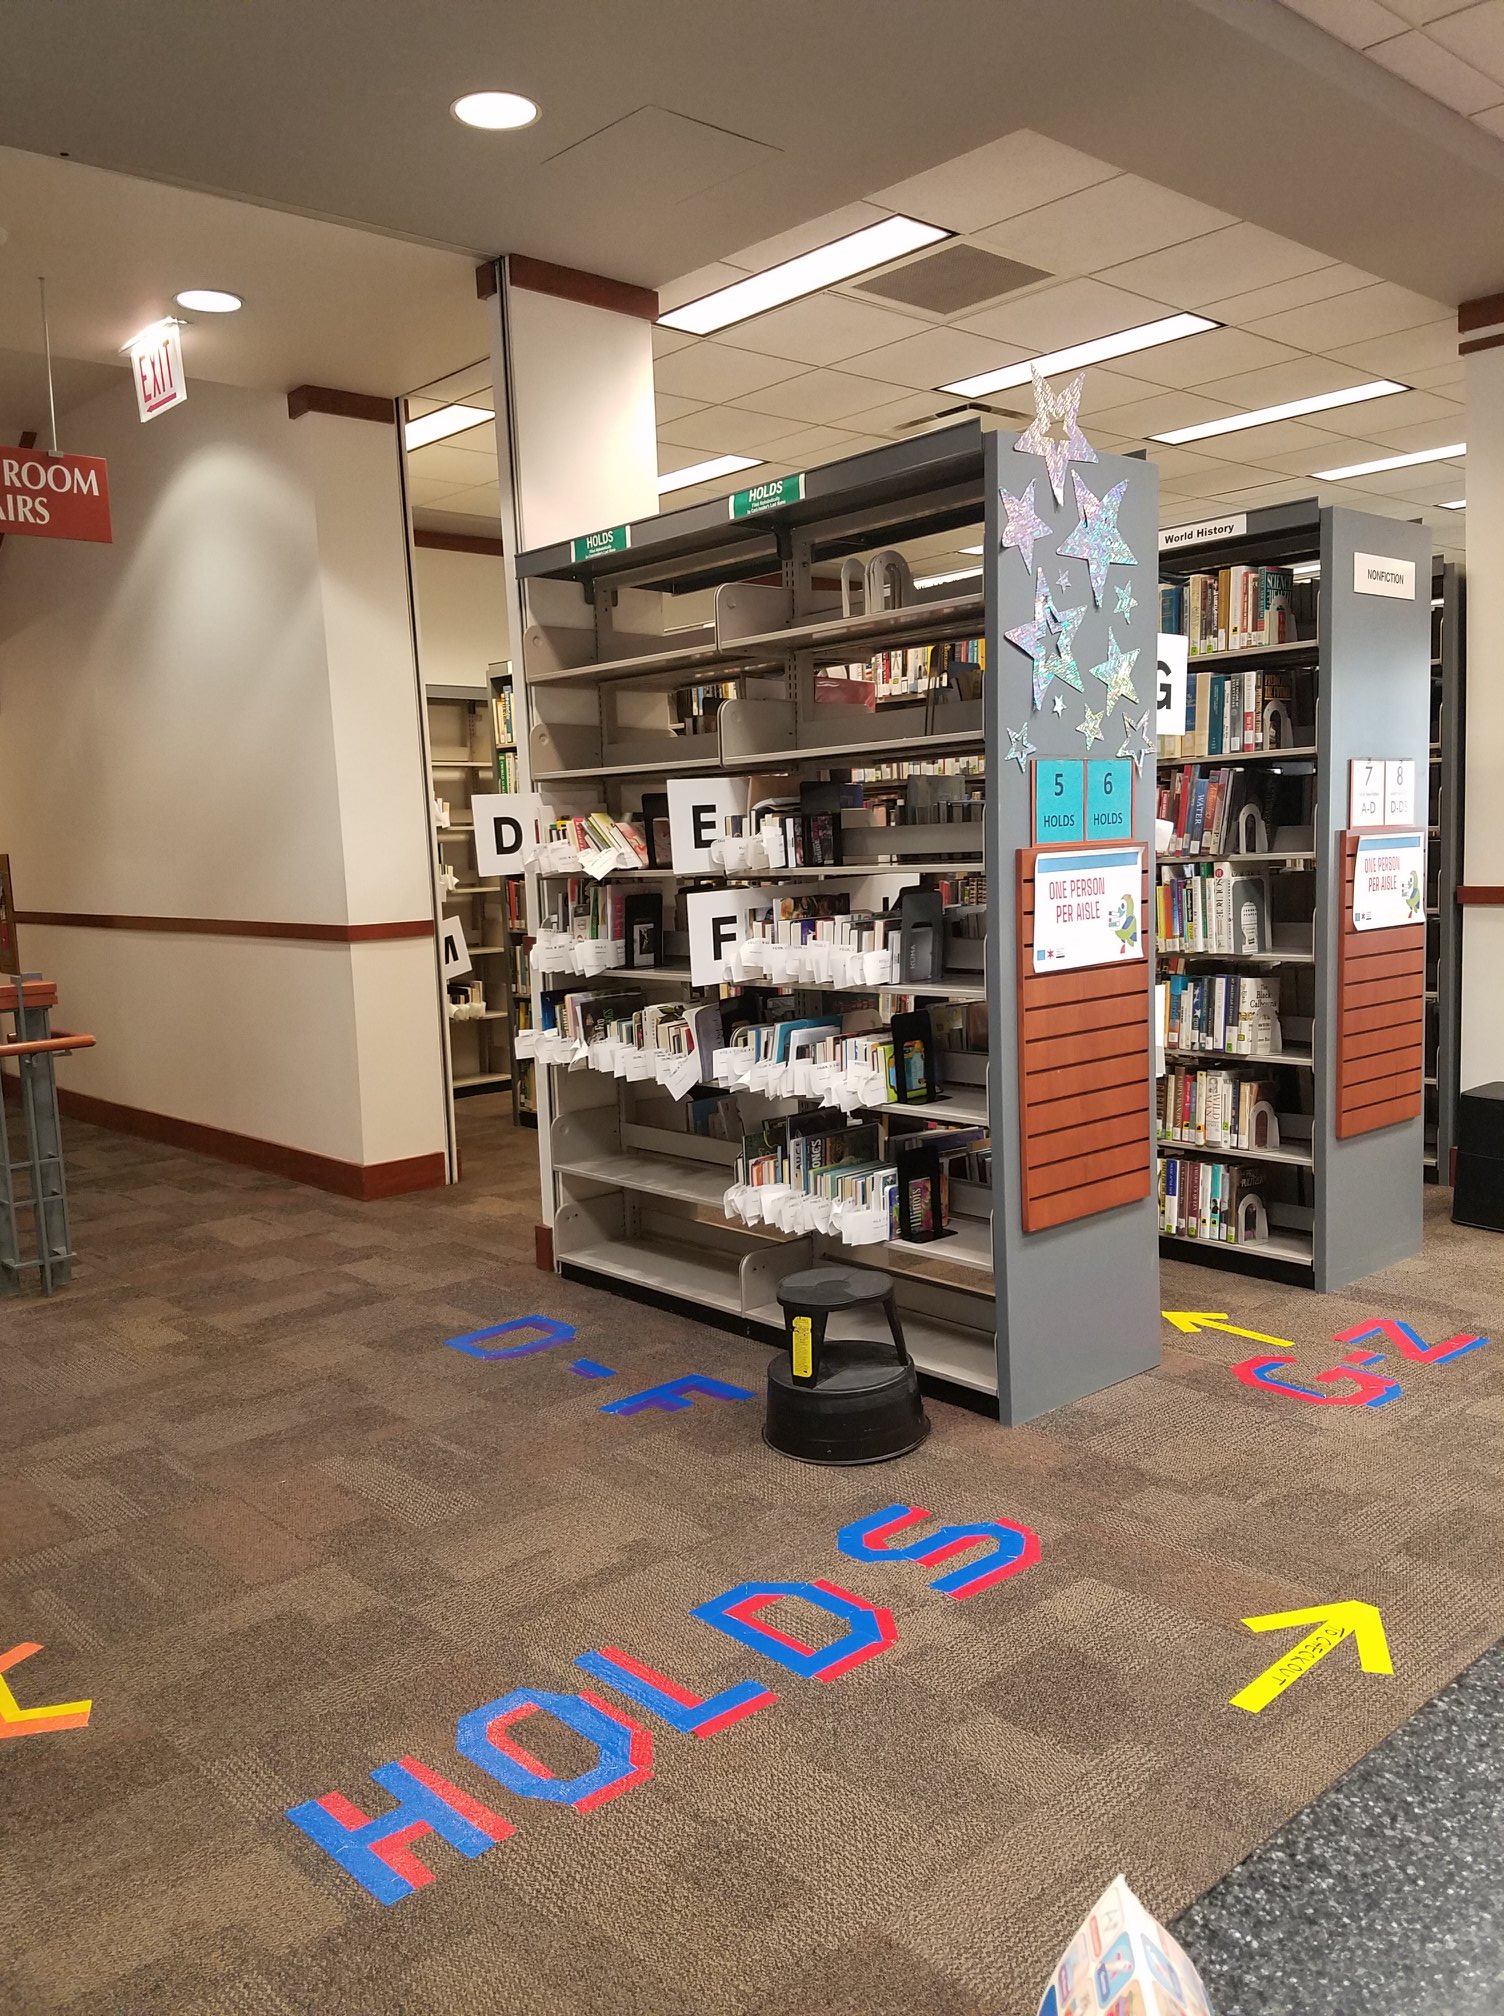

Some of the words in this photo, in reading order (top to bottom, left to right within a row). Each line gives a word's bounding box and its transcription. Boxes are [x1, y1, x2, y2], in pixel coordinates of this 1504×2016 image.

[138, 338, 173, 403] EXIT
[3, 458, 100, 497] ROOM
[749, 480, 784, 503] HOLDS
[586, 530, 614, 550] HOLDS
[1164, 530, 1194, 545] World
[1196, 522, 1235, 539] History
[1366, 567, 1405, 586] NONFICTION
[1156, 660, 1172, 710] G
[1054, 773, 1064, 797] 5
[1103, 772, 1113, 796] 6
[1364, 765, 1374, 786] 7
[1396, 764, 1404, 786] 8
[1043, 814, 1075, 828] HOLDS
[1093, 812, 1123, 826] HOLDS
[1195, 794, 1206, 826] WATER
[493, 816, 523, 856] D
[692, 804, 718, 850] E
[1364, 857, 1378, 873] ONE
[1378, 855, 1401, 872] PERSON
[1048, 880, 1068, 900] ONE
[1070, 876, 1105, 899] PERSON
[1368, 877, 1380, 893] PER
[1381, 875, 1397, 890] AISLE
[1056, 903, 1073, 924] PER
[1076, 900, 1101, 922] AISLE
[712, 915, 738, 962] F
[909, 1187, 922, 1228] Illinois
[1324, 1624, 1345, 1638] TO
[284, 1504, 1042, 1909] HOLDS
